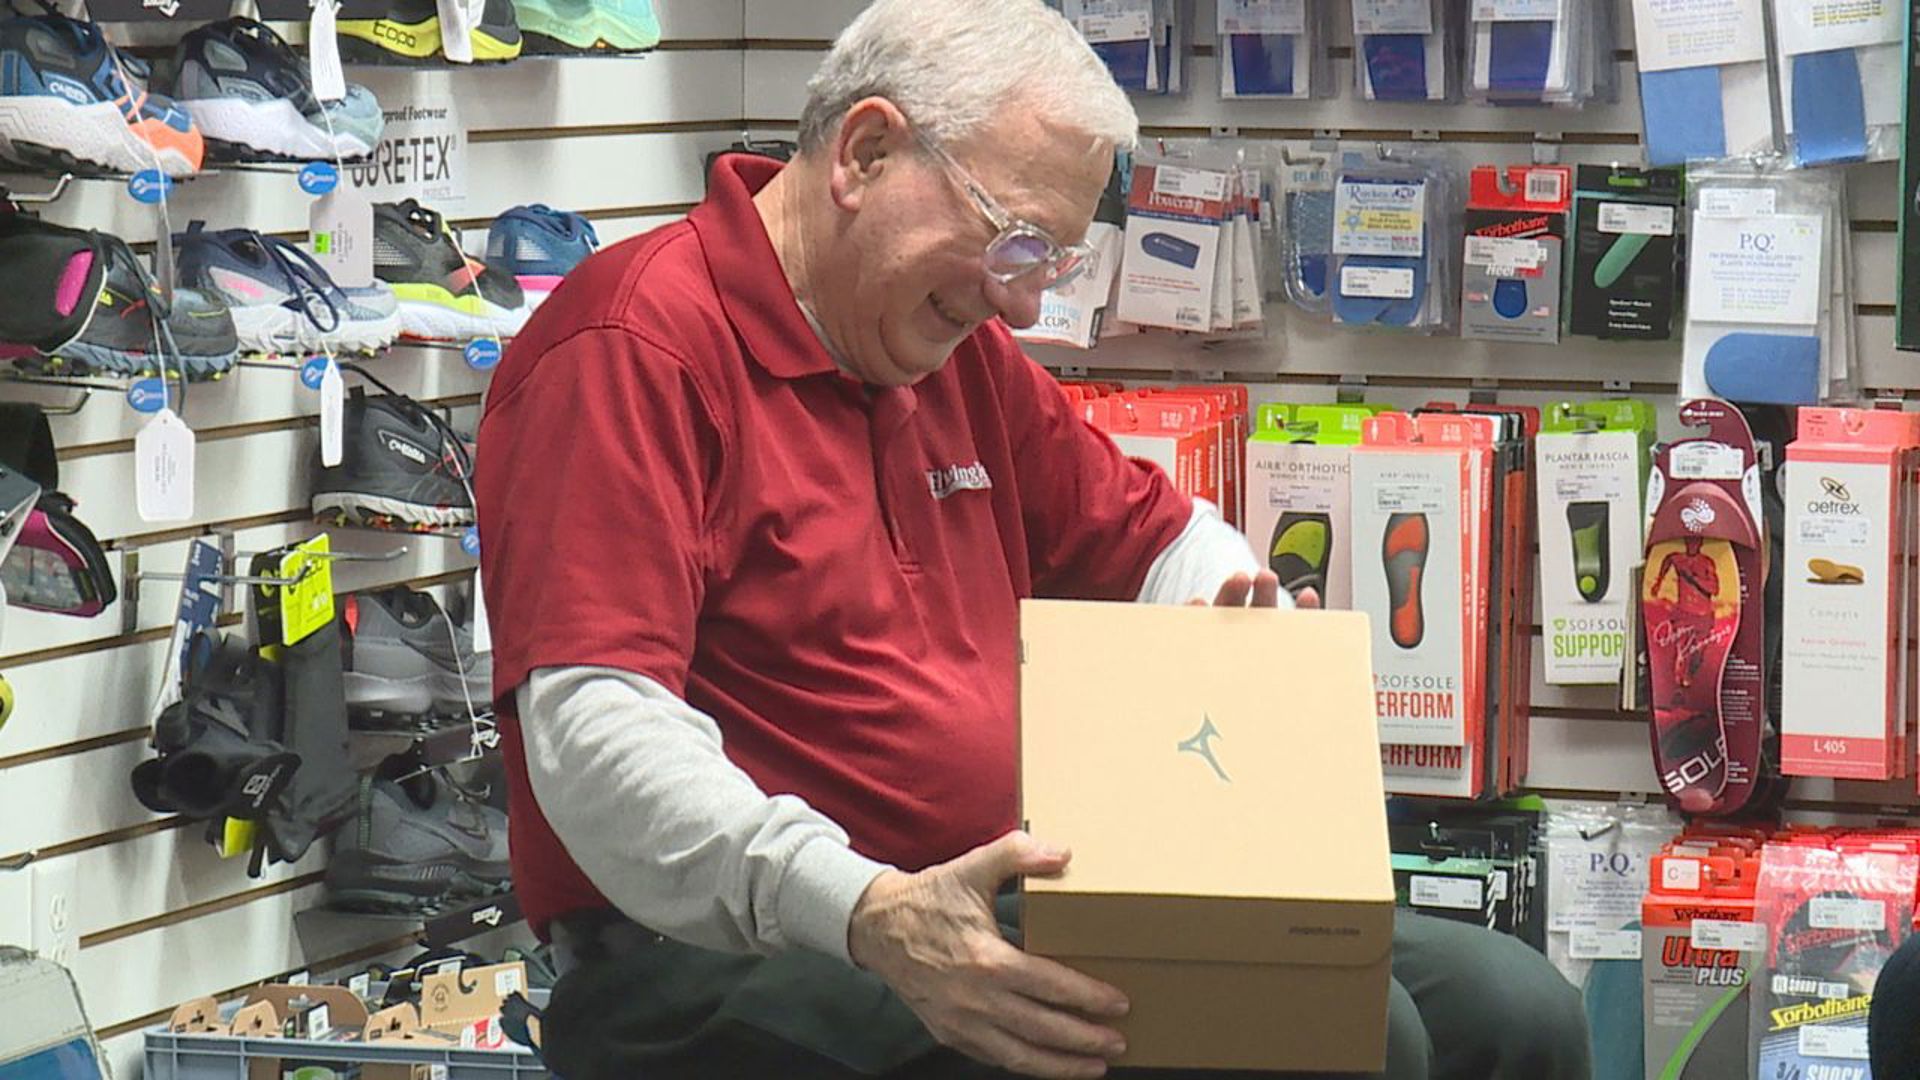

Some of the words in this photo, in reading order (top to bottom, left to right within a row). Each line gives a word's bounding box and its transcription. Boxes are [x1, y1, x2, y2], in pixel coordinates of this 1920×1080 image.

[409, 105, 448, 121] Footwear
[1807, 501, 1861, 515] aetrex
[1568, 618, 1627, 631] SOFSOL
[1553, 633, 1625, 658] SUPPOR
[1375, 691, 1453, 719] ERFORM
[1380, 744, 1462, 769] ERFORM
[1824, 740, 1846, 754] 405
[1696, 967, 1745, 986] PLUS
[1769, 993, 1872, 1029] Sorbothane
